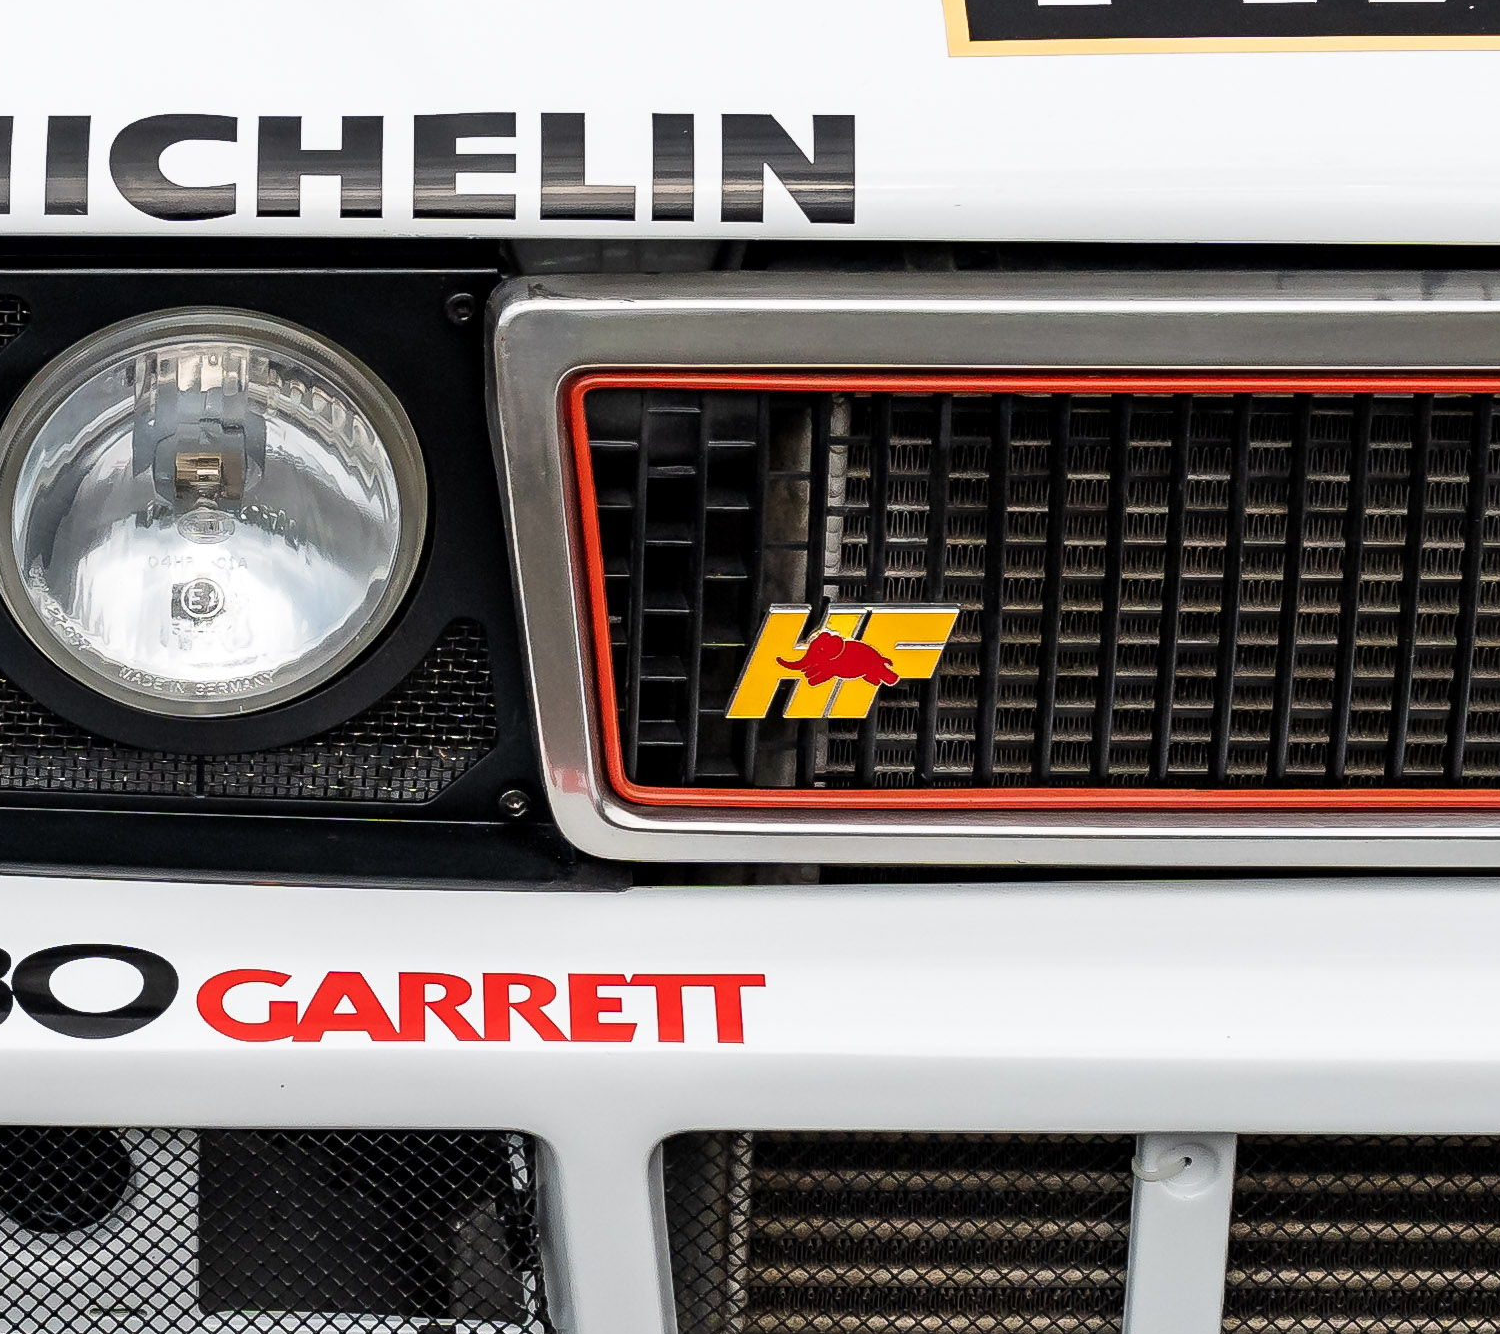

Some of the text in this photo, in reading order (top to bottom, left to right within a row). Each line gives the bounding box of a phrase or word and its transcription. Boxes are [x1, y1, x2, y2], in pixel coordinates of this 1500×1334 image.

[117, 665, 275, 695] MADE IN GERMANY
[725, 603, 961, 719] HF
[197, 969, 765, 1043] GARRETT
